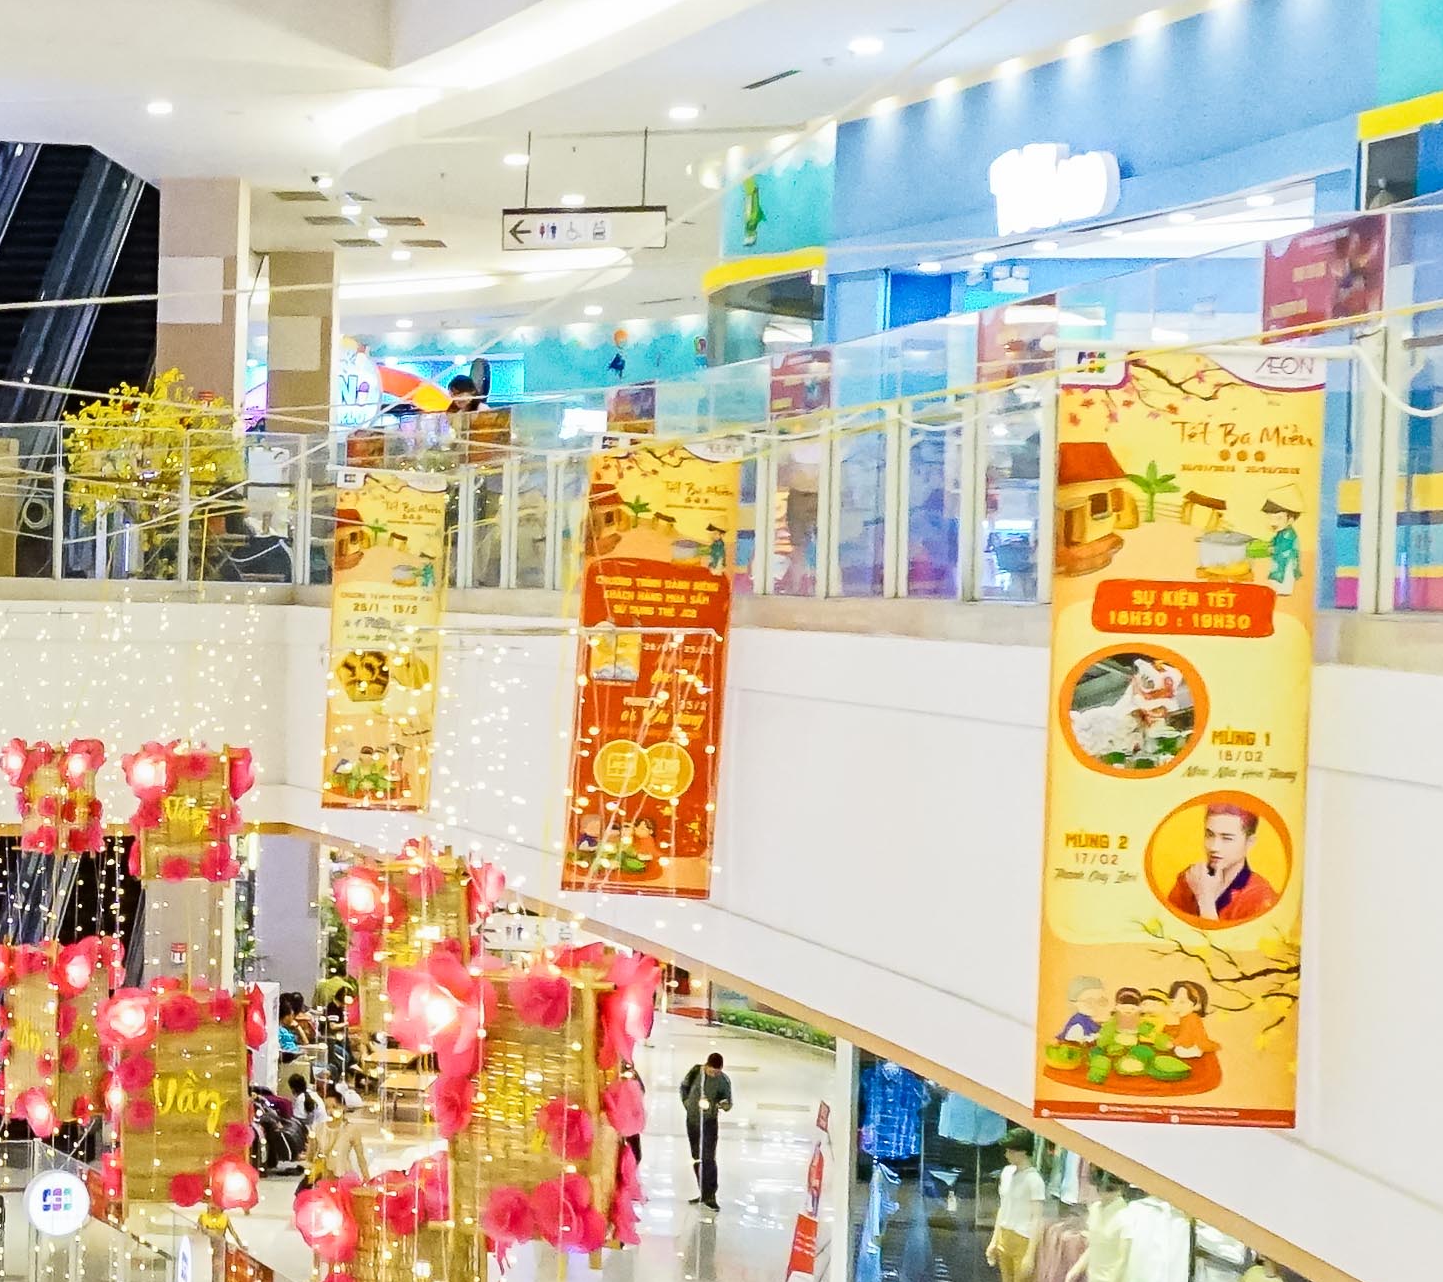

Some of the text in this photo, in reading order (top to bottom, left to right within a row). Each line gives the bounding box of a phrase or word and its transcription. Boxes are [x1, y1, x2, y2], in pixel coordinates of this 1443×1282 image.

[1220, 422, 1253, 446] Ba
[1206, 587, 1237, 609] TẾT
[1118, 836, 1130, 849] 2
[1074, 852, 1119, 866] 17/02
